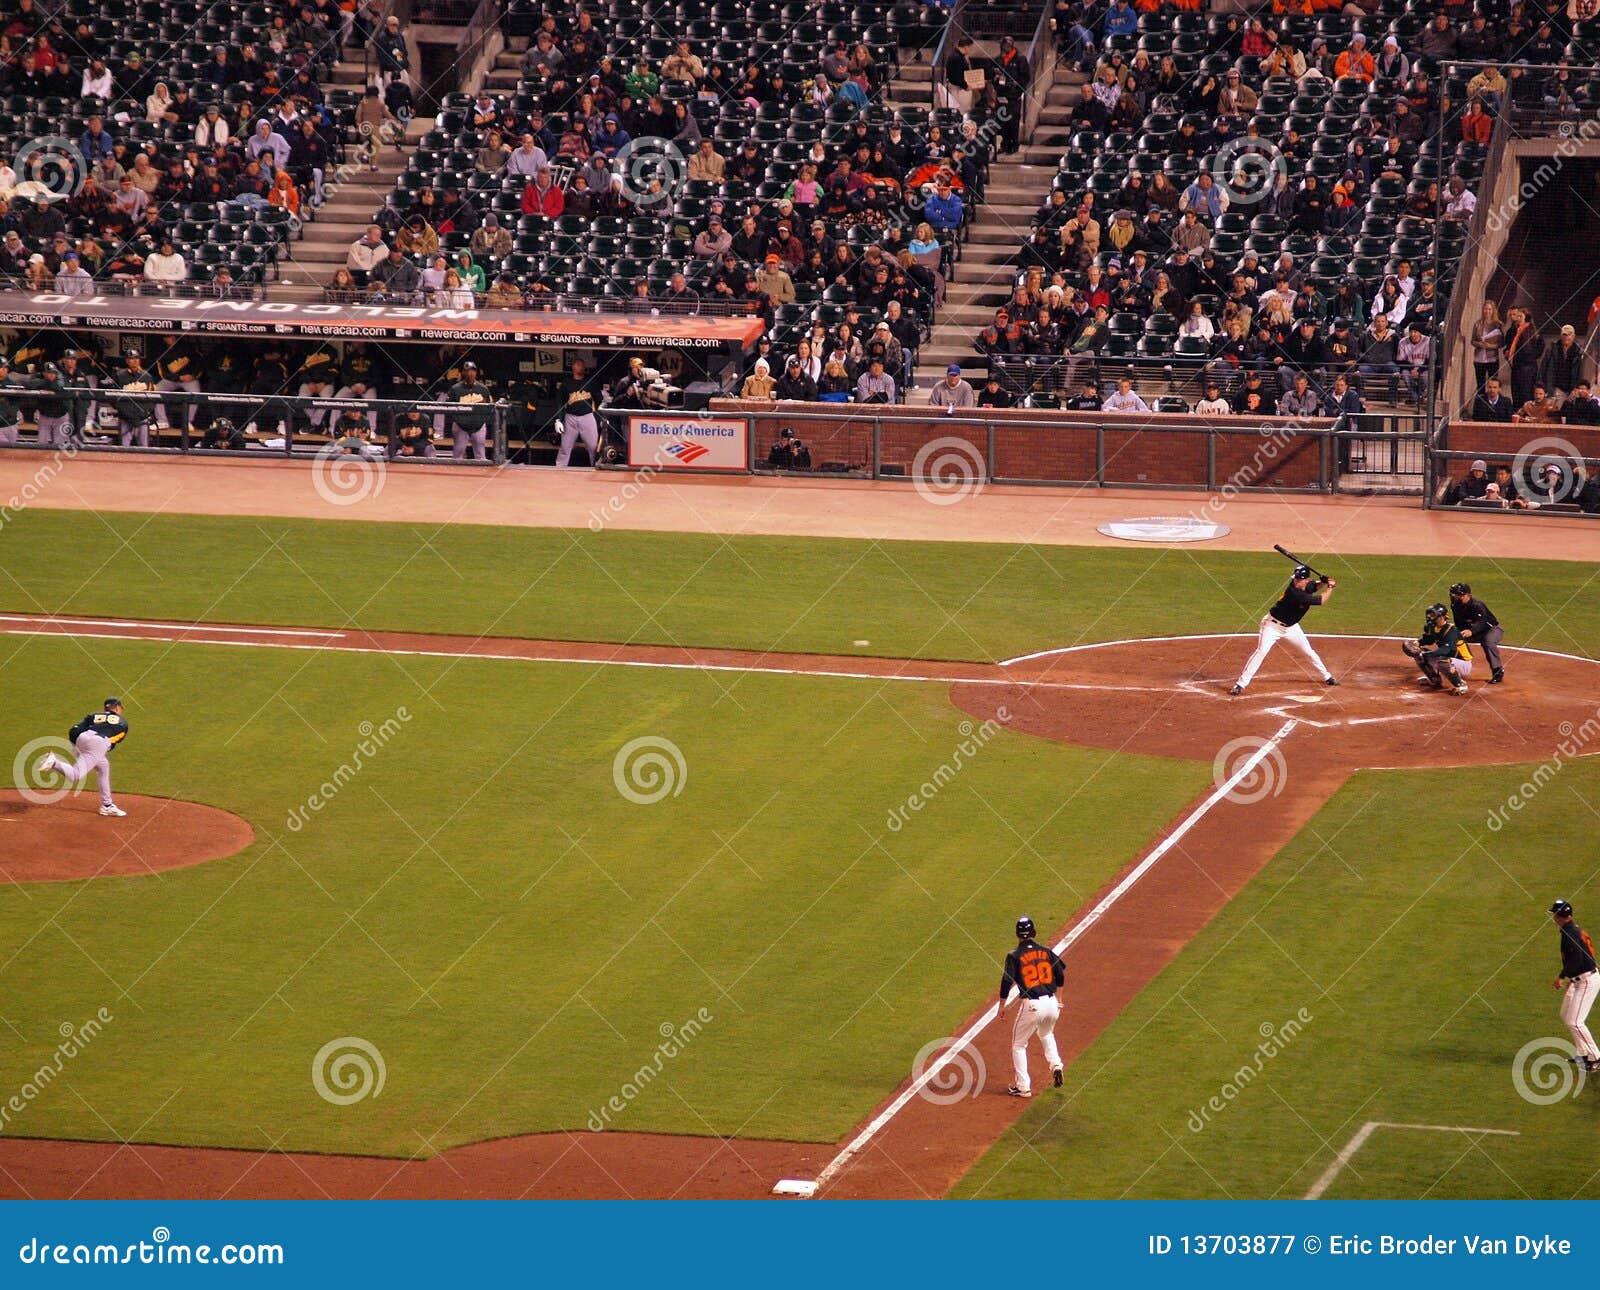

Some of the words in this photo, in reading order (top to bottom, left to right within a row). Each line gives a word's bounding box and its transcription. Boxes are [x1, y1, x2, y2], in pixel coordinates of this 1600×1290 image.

[86, 316, 173, 329] neweracap.com
[206, 322, 266, 333] SFGIANTS.com
[420, 329, 507, 341] neweracap.com
[540, 334, 600, 344] SFGIANTS.com
[633, 336, 720, 348] neweracap.com
[640, 422, 670, 435] Bank
[672, 424, 684, 435] of
[685, 424, 735, 437] America
[1021, 961, 1053, 989] 20
